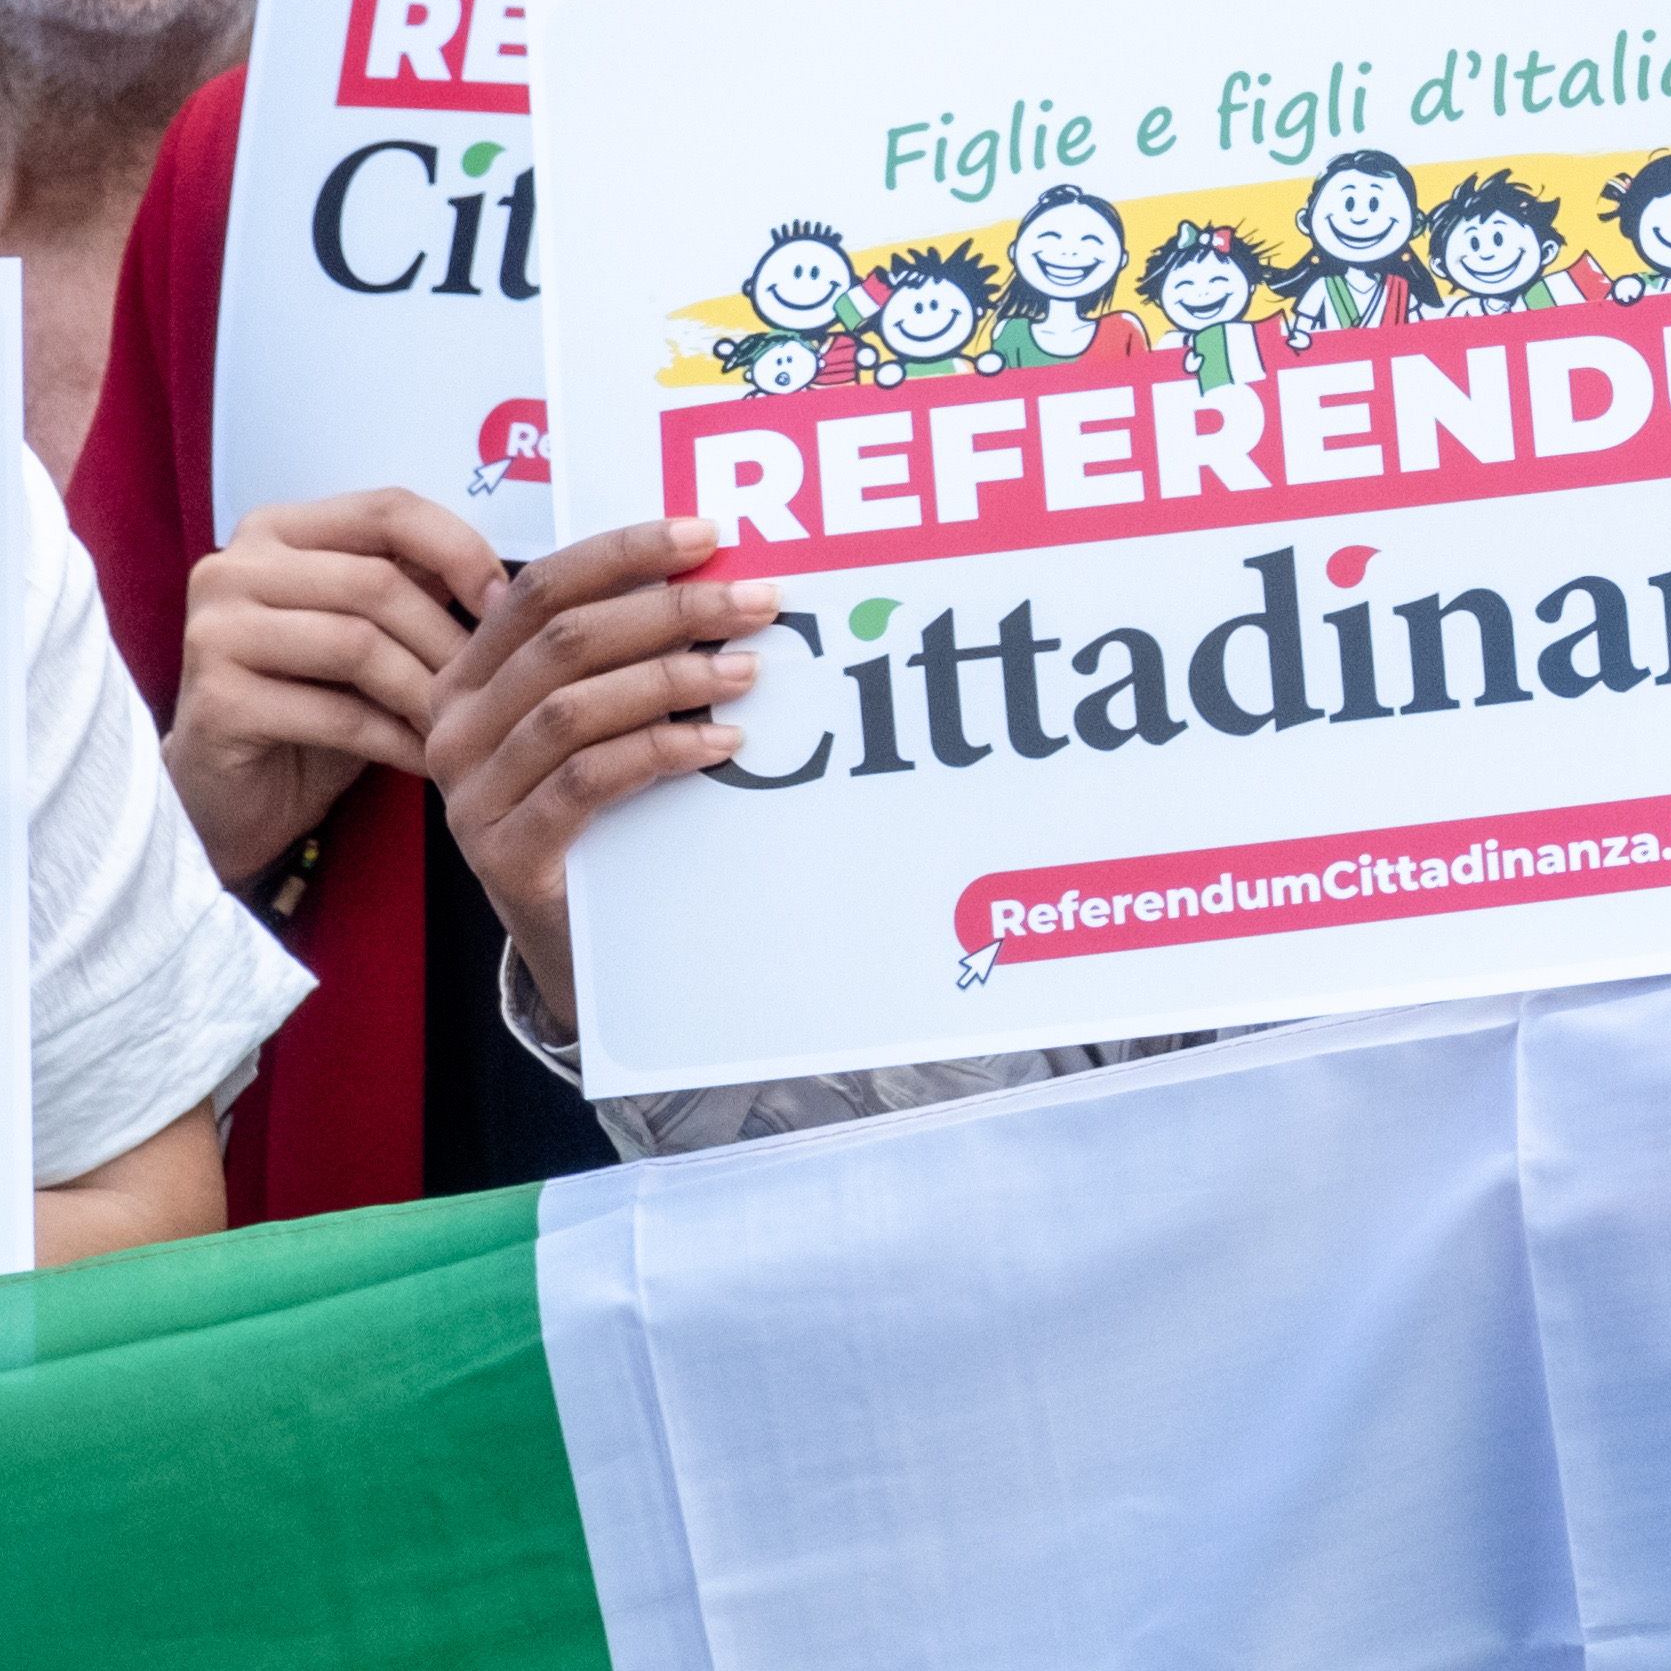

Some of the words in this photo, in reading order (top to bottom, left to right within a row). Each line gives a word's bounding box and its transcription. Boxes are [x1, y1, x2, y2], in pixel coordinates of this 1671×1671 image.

[885, 99, 1097, 202] Figlie
[1137, 107, 1177, 156] e
[1217, 61, 1373, 165] figli
